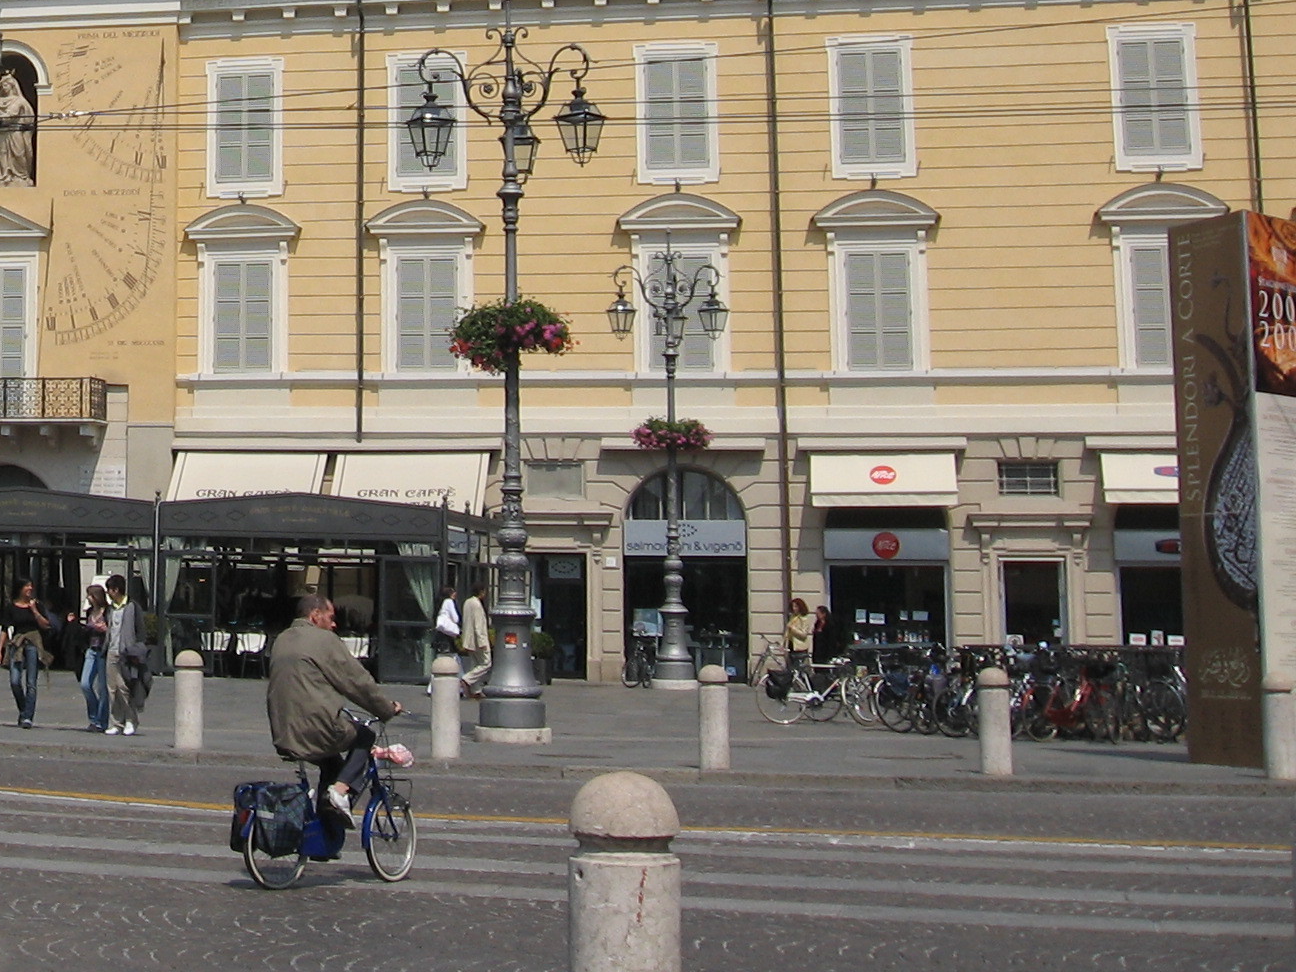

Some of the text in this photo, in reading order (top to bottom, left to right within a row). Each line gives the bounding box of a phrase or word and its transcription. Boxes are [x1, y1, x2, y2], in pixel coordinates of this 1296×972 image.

[1177, 233, 1203, 502] SPLENDORI A CORTE
[195, 488, 238, 498] GRAN
[356, 485, 456, 498] GRAN CAFFÈ
